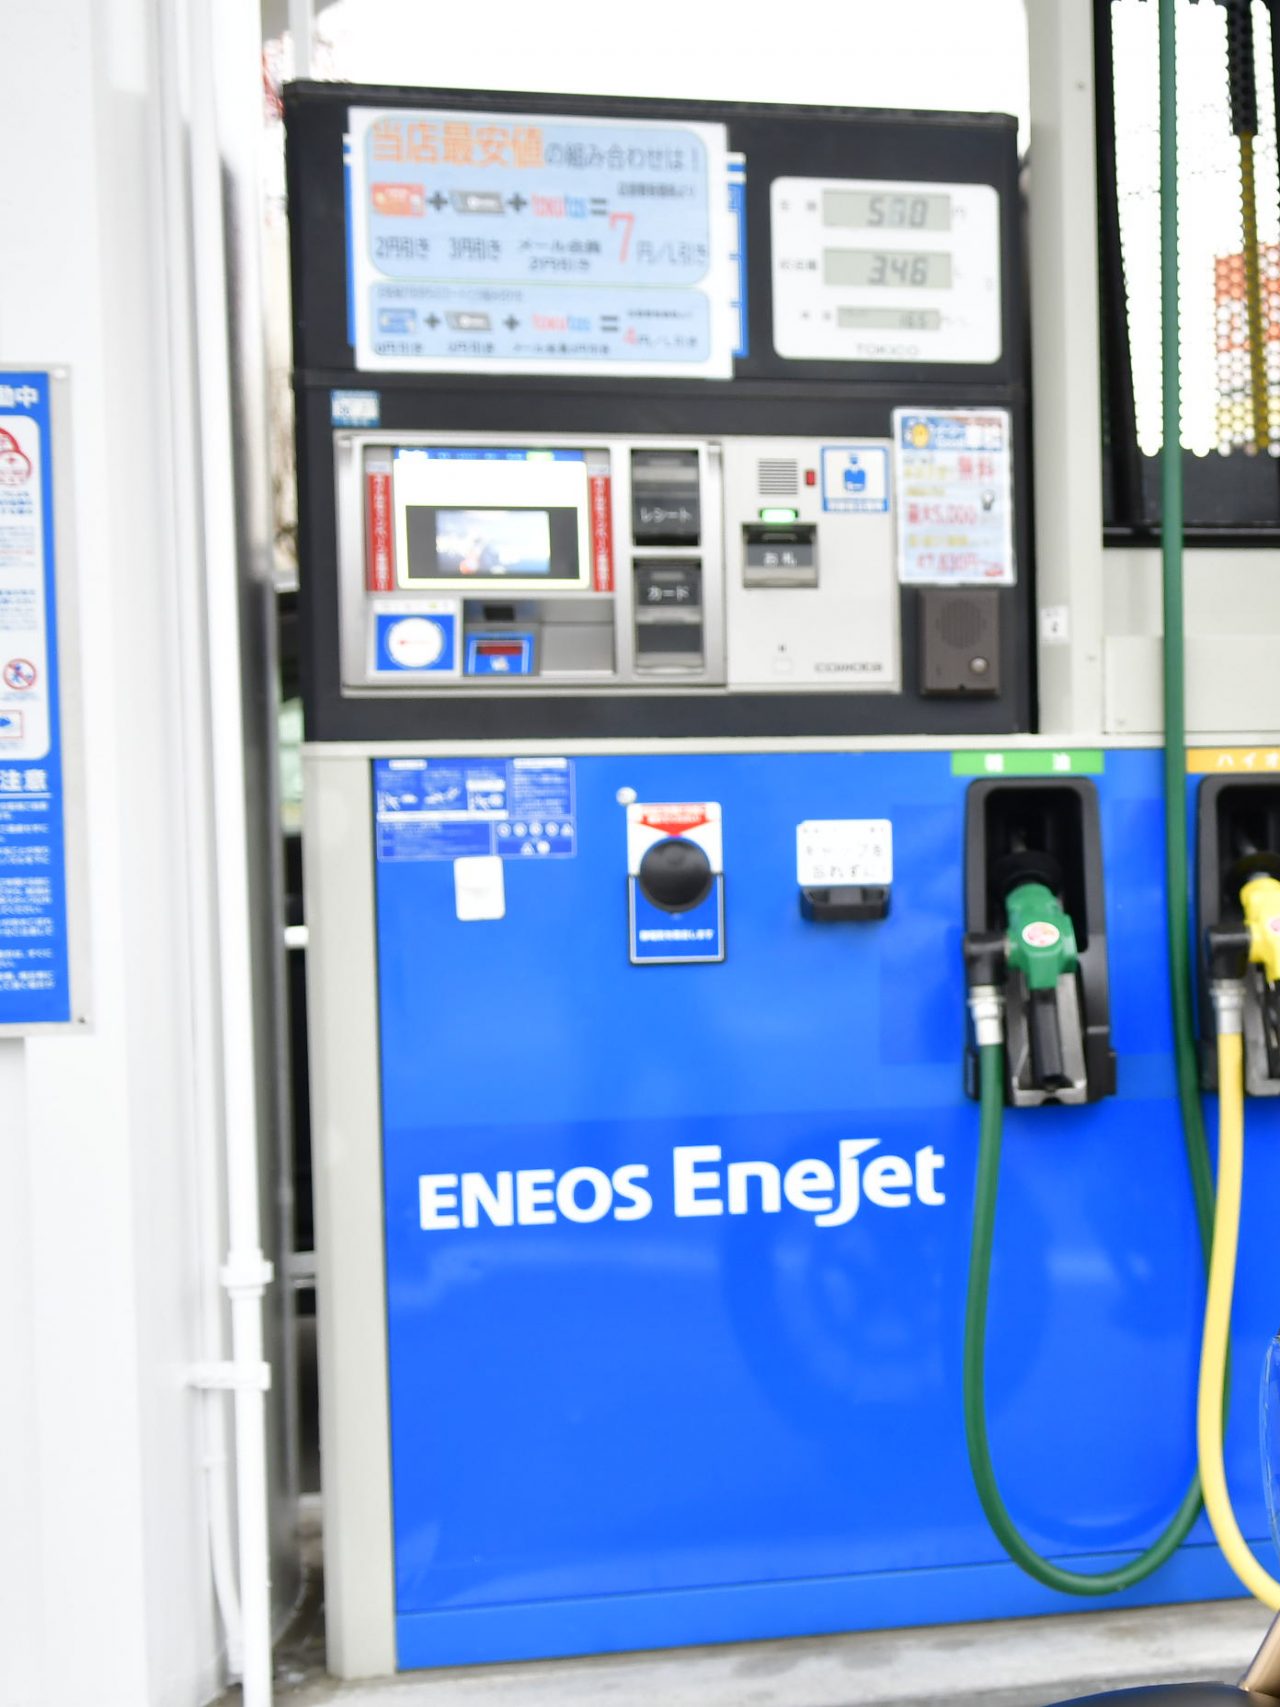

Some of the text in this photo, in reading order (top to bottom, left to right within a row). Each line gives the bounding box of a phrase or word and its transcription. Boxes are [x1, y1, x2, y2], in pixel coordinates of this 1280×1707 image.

[640, 506, 692, 523] レシート
[648, 585, 690, 601] カード
[418, 1164, 653, 1230] ENEOS
